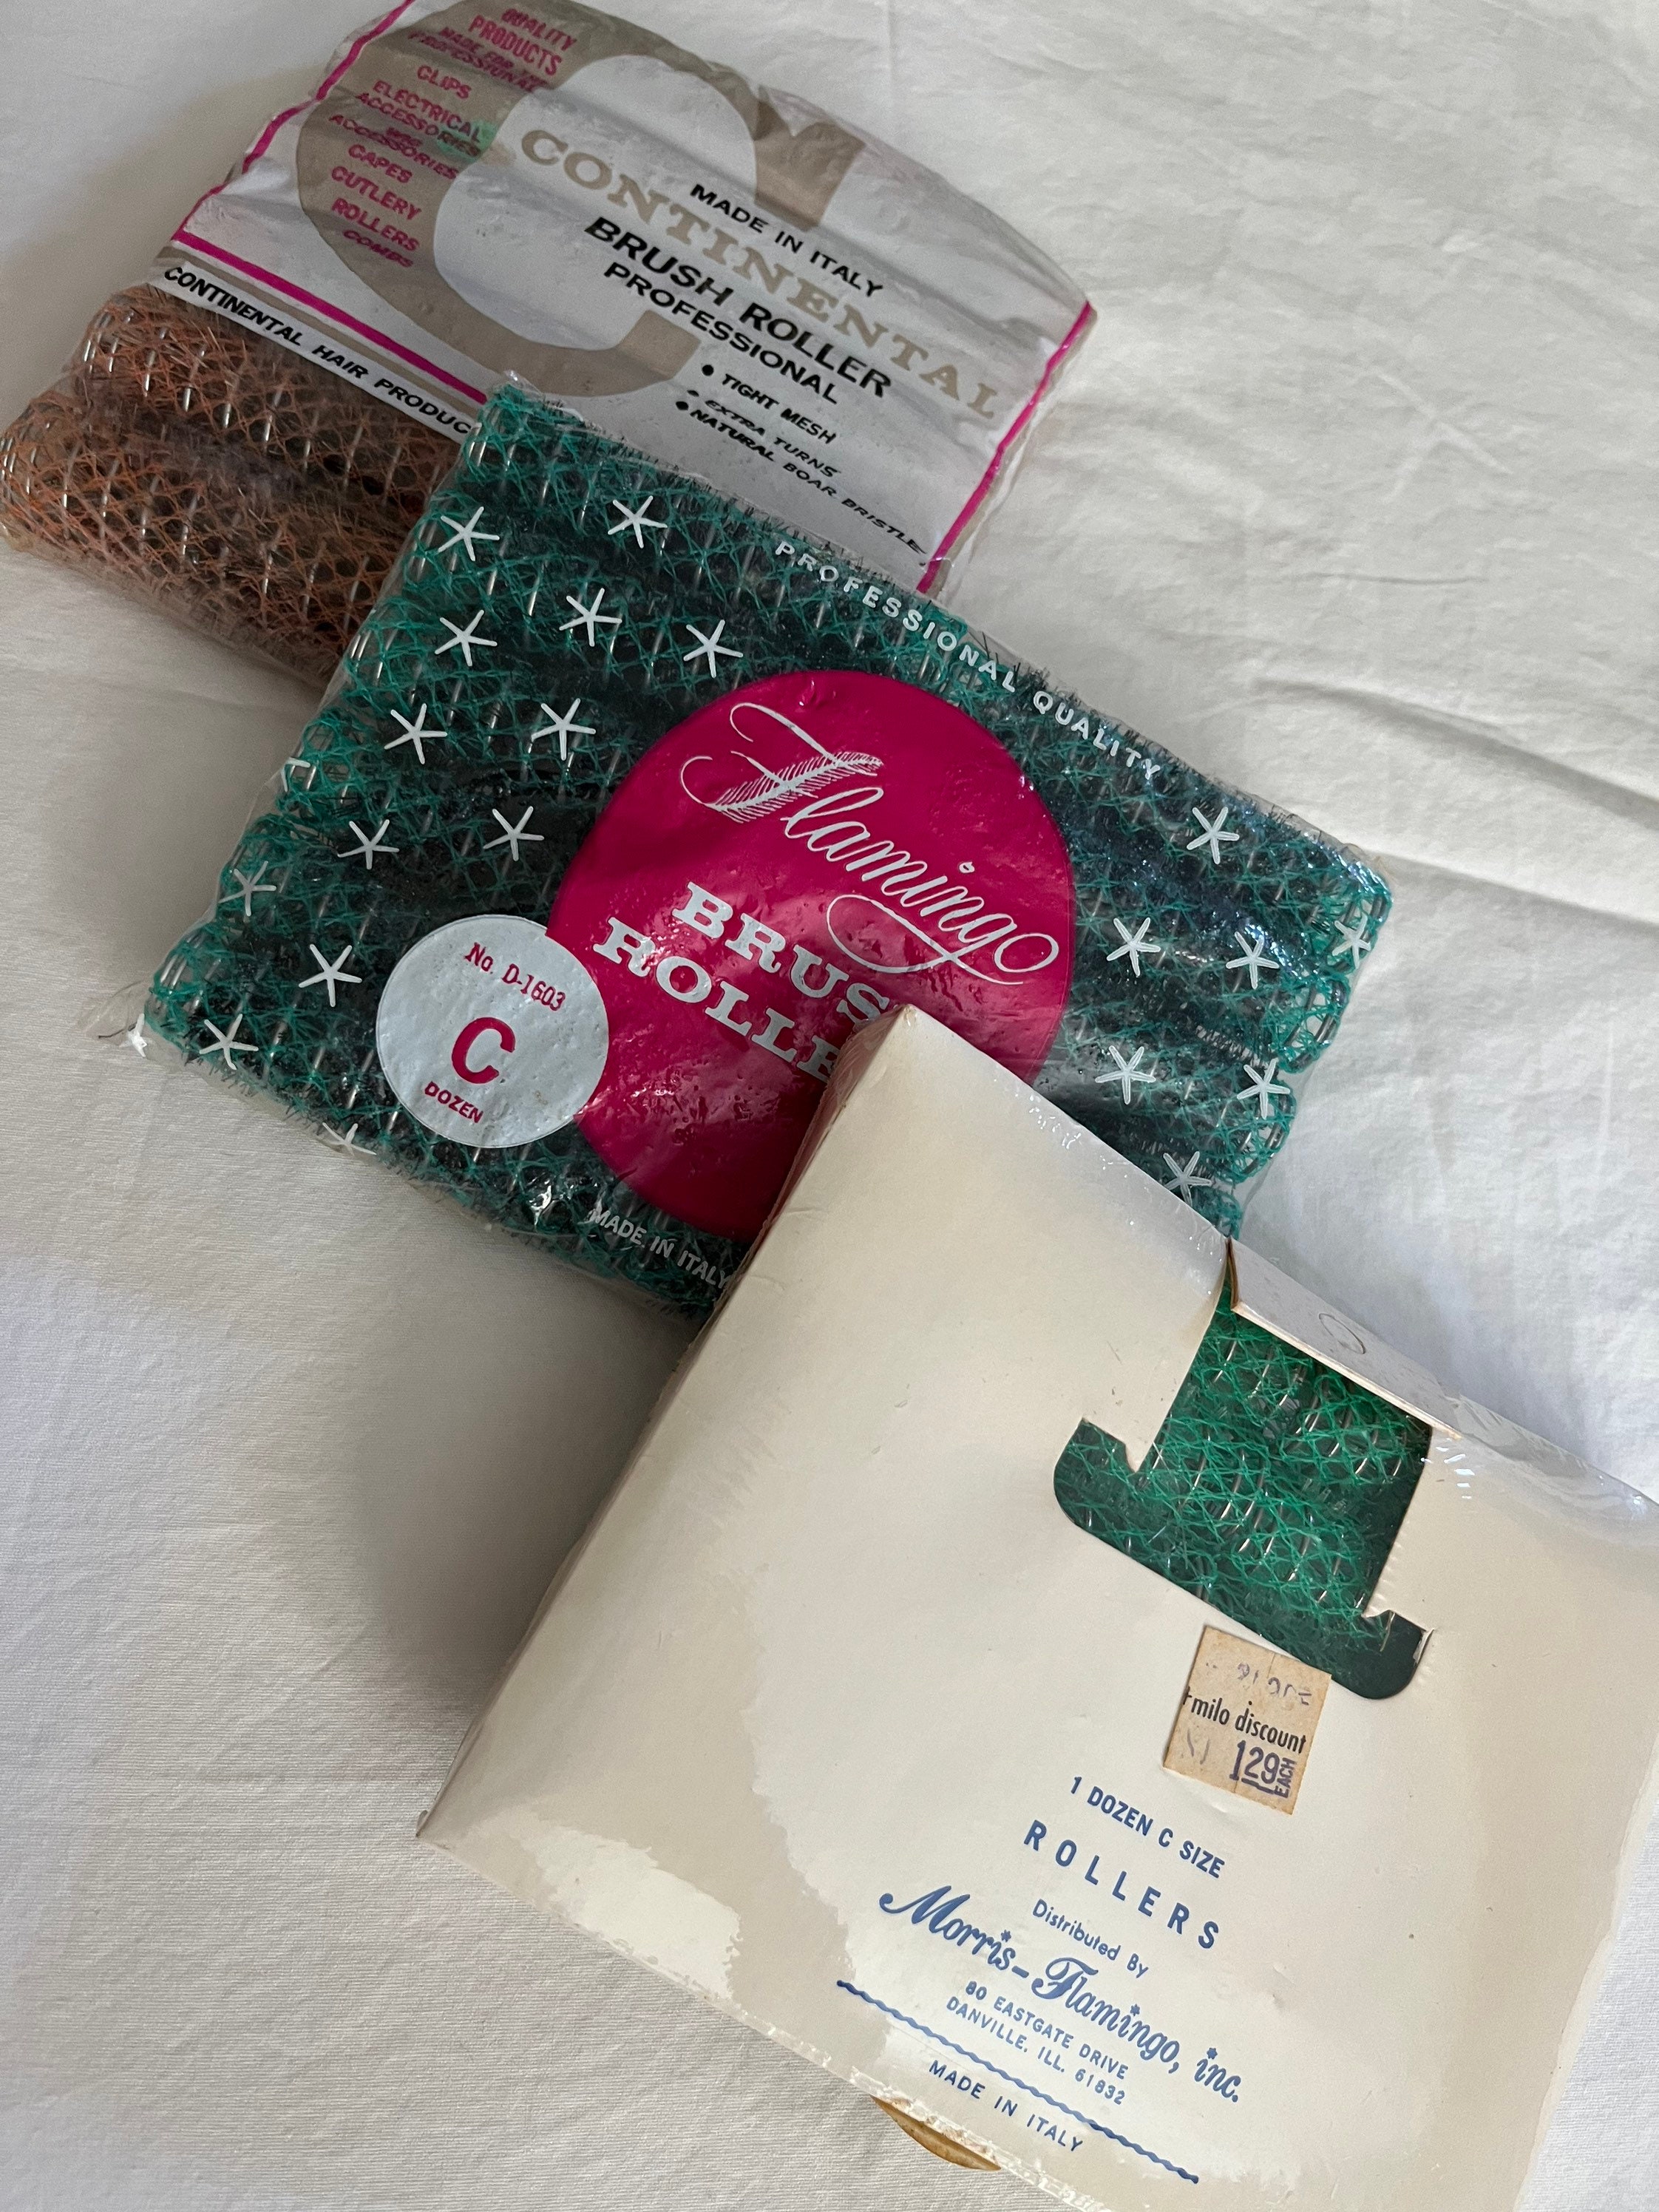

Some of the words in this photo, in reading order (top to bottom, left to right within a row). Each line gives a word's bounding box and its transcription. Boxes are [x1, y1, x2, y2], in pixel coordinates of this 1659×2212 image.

[469, 15, 562, 76] PRODUCTS
[501, 8, 577, 52] QUALITY
[373, 80, 481, 143] ELECTRICAL
[417, 65, 471, 100] CLIPS
[329, 115, 460, 180] ACCESSORIES
[356, 92, 481, 157] ACCESSORIES
[331, 166, 421, 220] CUTLERY
[348, 144, 413, 183] CAPES
[332, 197, 420, 251] ROLLERS
[344, 229, 413, 268] COMBS
[691, 184, 769, 233] MADE
[775, 231, 804, 253] IN
[810, 251, 883, 297] ITALY
[520, 129, 996, 419] CONTINENTAL
[584, 217, 733, 307] BRUSH
[739, 302, 892, 398] ROLLER
[164, 266, 302, 346] CONTINENTAL
[312, 345, 370, 379] HAIR
[604, 262, 839, 404] PROFESSIONAL
[705, 400, 765, 436] EXTRA
[774, 437, 841, 478] TURNS
[722, 373, 780, 410] TIGHT
[781, 408, 836, 444] MESH
[690, 409, 776, 462] NATURAL
[783, 463, 837, 497] BOAR
[776, 540, 1017, 693] PROFESSIONAL
[1034, 690, 1161, 780] QUALITY
[679, 702, 1059, 985] Flamingo
[464, 942, 493, 974] No.
[502, 963, 566, 1011] D-1603
[452, 1017, 515, 1084] C
[424, 1081, 484, 1123] DOZEN
[589, 1209, 647, 1245] MADE
[649, 1235, 675, 1258] IN
[677, 1250, 730, 1289] ITALY
[1235, 1700, 1306, 1754] discount
[1275, 1757, 1297, 1798] EACH
[1071, 1776, 1082, 1794] 1
[1088, 1786, 1153, 1836] DOZEN
[1158, 1828, 1173, 1848] C
[1180, 1839, 1226, 1879] SIZE
[1024, 1820, 1219, 1949] ROLLERS
[1032, 1899, 1122, 1961] Distributed
[1127, 1954, 1149, 1978] By
[879, 1884, 1181, 2074] Morris-Flamingo,
[1194, 2047, 1241, 2103] inc.
[966, 1981, 987, 2001] 80
[994, 1995, 1073, 2049] EASTGATE
[1079, 2042, 1129, 2080] DRIVE
[929, 2060, 985, 2100] MADE
[994, 2095, 1018, 2117] IN
[1027, 2115, 1084, 2153] ITALY
[1037, 2046, 1065, 2073] ILL.
[1075, 2068, 1126, 2105] 61832
